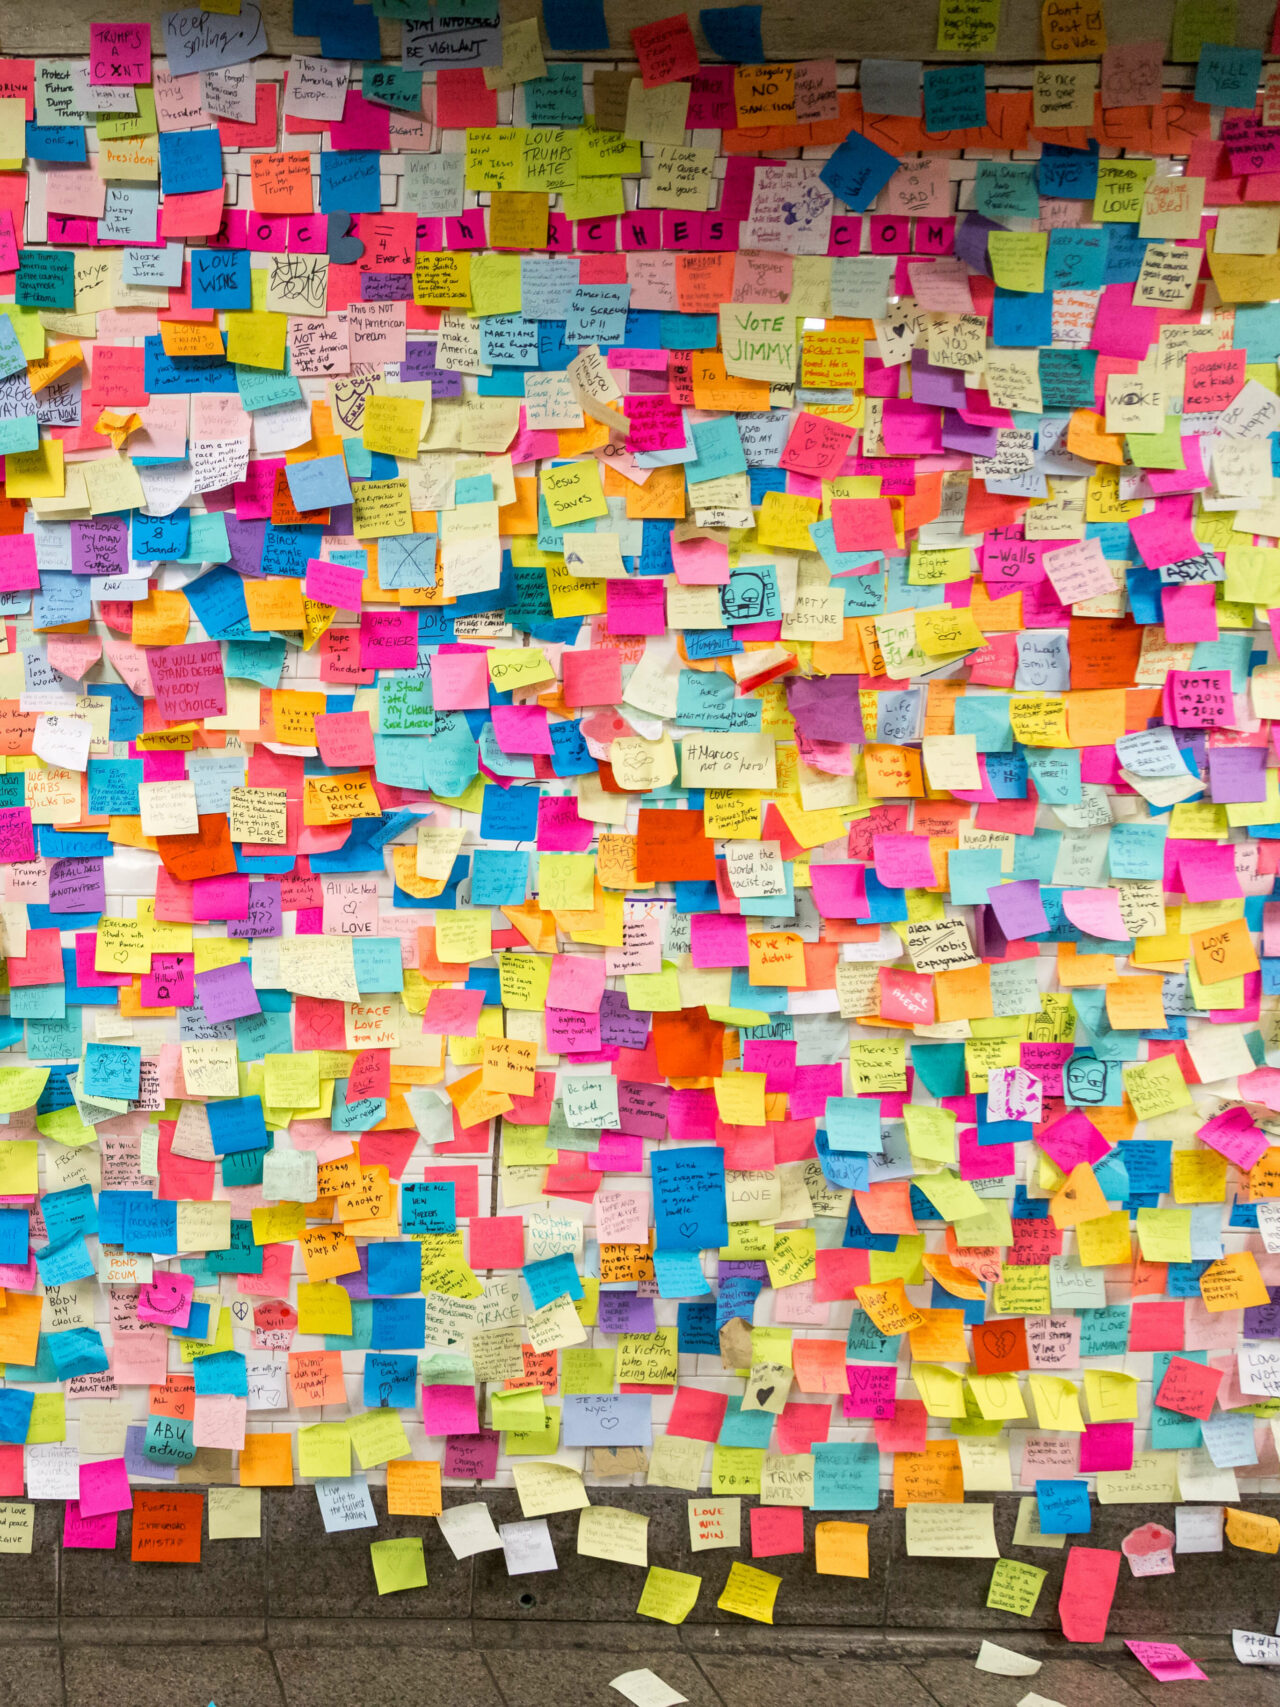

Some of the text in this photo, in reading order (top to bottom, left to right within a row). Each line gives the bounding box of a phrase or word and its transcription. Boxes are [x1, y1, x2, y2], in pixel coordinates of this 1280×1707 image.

[167, 14, 209, 38] Keep
[1051, 36, 1097, 49] Go Vote
[43, 69, 70, 80] Protect
[1038, 70, 1076, 85] Be nice
[45, 84, 73, 93] Future
[752, 84, 779, 96] NO
[47, 97, 72, 110] Dump
[525, 131, 564, 144] LOVE
[524, 147, 573, 162] TRUMPS
[527, 162, 564, 176] HATE
[1107, 184, 1134, 194] THE
[1103, 198, 1139, 212] LOVE
[199, 253, 238, 269] LOVE
[199, 273, 237, 290] WINS
[735, 315, 785, 332] VOTE
[440, 343, 479, 356] America
[446, 356, 481, 368] great!
[729, 344, 793, 370] JIMMY
[548, 472, 581, 491] Jesus
[786, 610, 837, 626] GESTURE
[1179, 679, 1221, 691] VOTE
[688, 744, 740, 761] #Marcos
[700, 760, 717, 772] not
[602, 845, 635, 858] NEED
[731, 848, 775, 862] Love the
[12, 866, 47, 878] Trumps
[341, 921, 372, 934] LOVE
[908, 923, 931, 935] alea
[908, 935, 929, 946] est
[935, 939, 968, 955] nobis
[1202, 932, 1232, 949] LOVE
[350, 1005, 391, 1017] PEACE
[354, 1019, 383, 1030] LOVE
[732, 1188, 771, 1202] LOVE
[110, 1258, 139, 1268] POND
[1056, 1275, 1096, 1288] Humble
[49, 1294, 78, 1306] BODY
[51, 1315, 84, 1326] CHOICE
[476, 1305, 520, 1323] GRACE
[575, 1395, 620, 1405] JE SUIS
[154, 1422, 184, 1444] ABU
[770, 1471, 812, 1484] TRUMPS
[1107, 1482, 1173, 1494] DIVERSITY
[693, 1507, 726, 1517] LOVE
